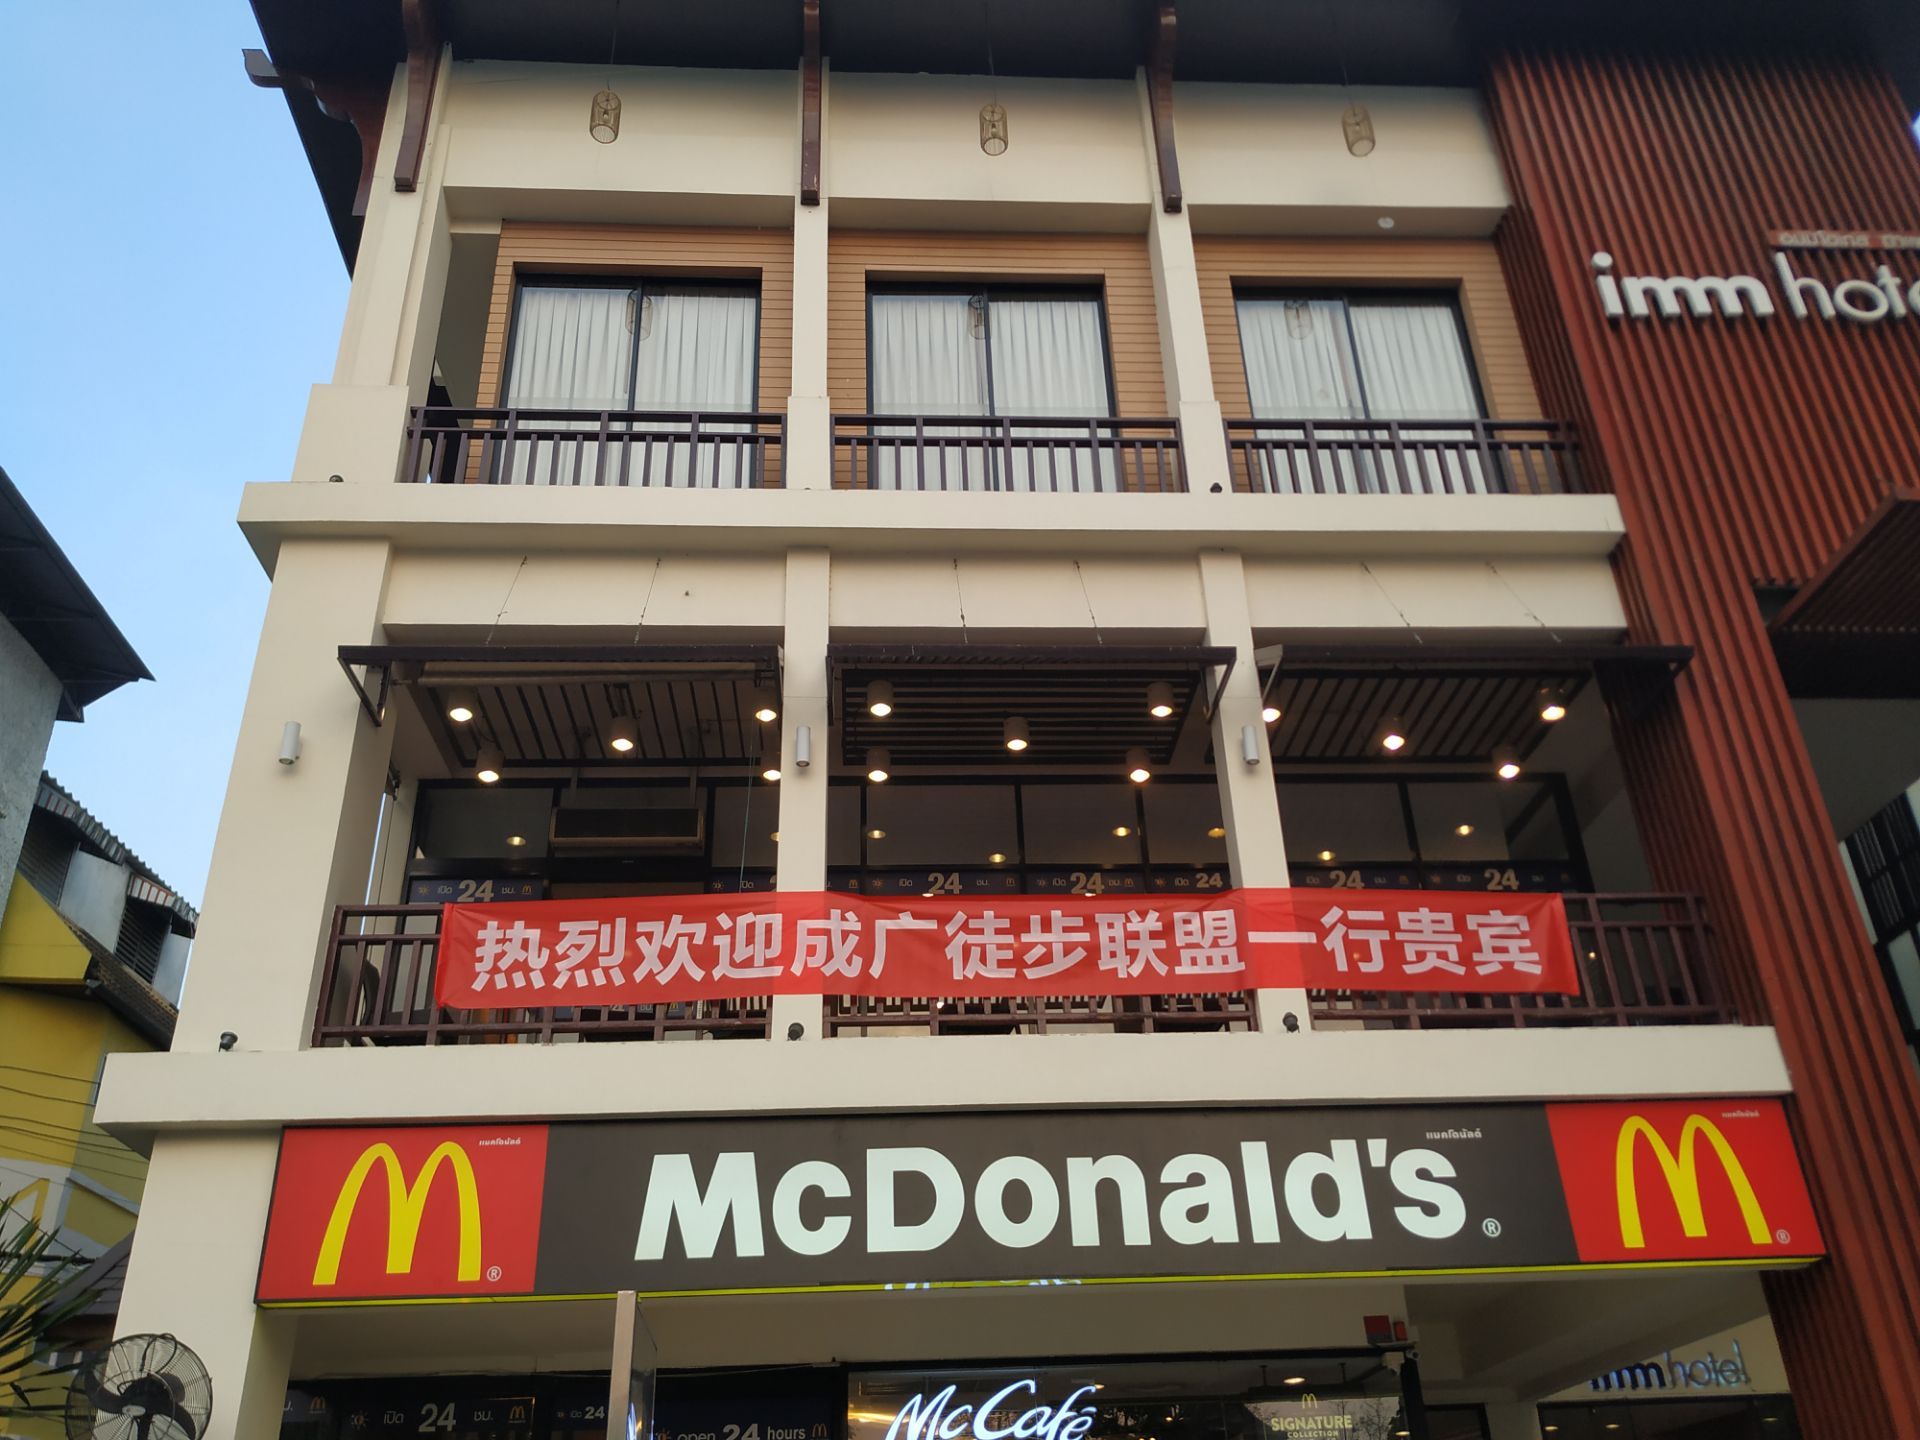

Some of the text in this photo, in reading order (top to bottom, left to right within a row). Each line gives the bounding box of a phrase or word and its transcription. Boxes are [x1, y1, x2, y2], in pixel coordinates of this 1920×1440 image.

[1774, 251, 1920, 323] hot
[927, 872, 963, 895] 24
[1070, 872, 1105, 894] 24
[1195, 872, 1224, 889] 24
[1329, 870, 1365, 890] 24
[1484, 868, 1520, 891] 24
[457, 880, 494, 903] 24
[471, 905, 1543, 992] 热烈欢迎成广徒步联盟一行贵宾
[634, 1137, 1467, 1261] McDonald's
[418, 1402, 456, 1433] 24
[584, 1405, 606, 1420] 24
[884, 1379, 1098, 1440] McCafé
[722, 1423, 761, 1440] 24
[767, 1426, 806, 1440] hours
[1271, 1414, 1353, 1432] SIGNATURE
[1287, 1430, 1339, 1438] COLLECTION
